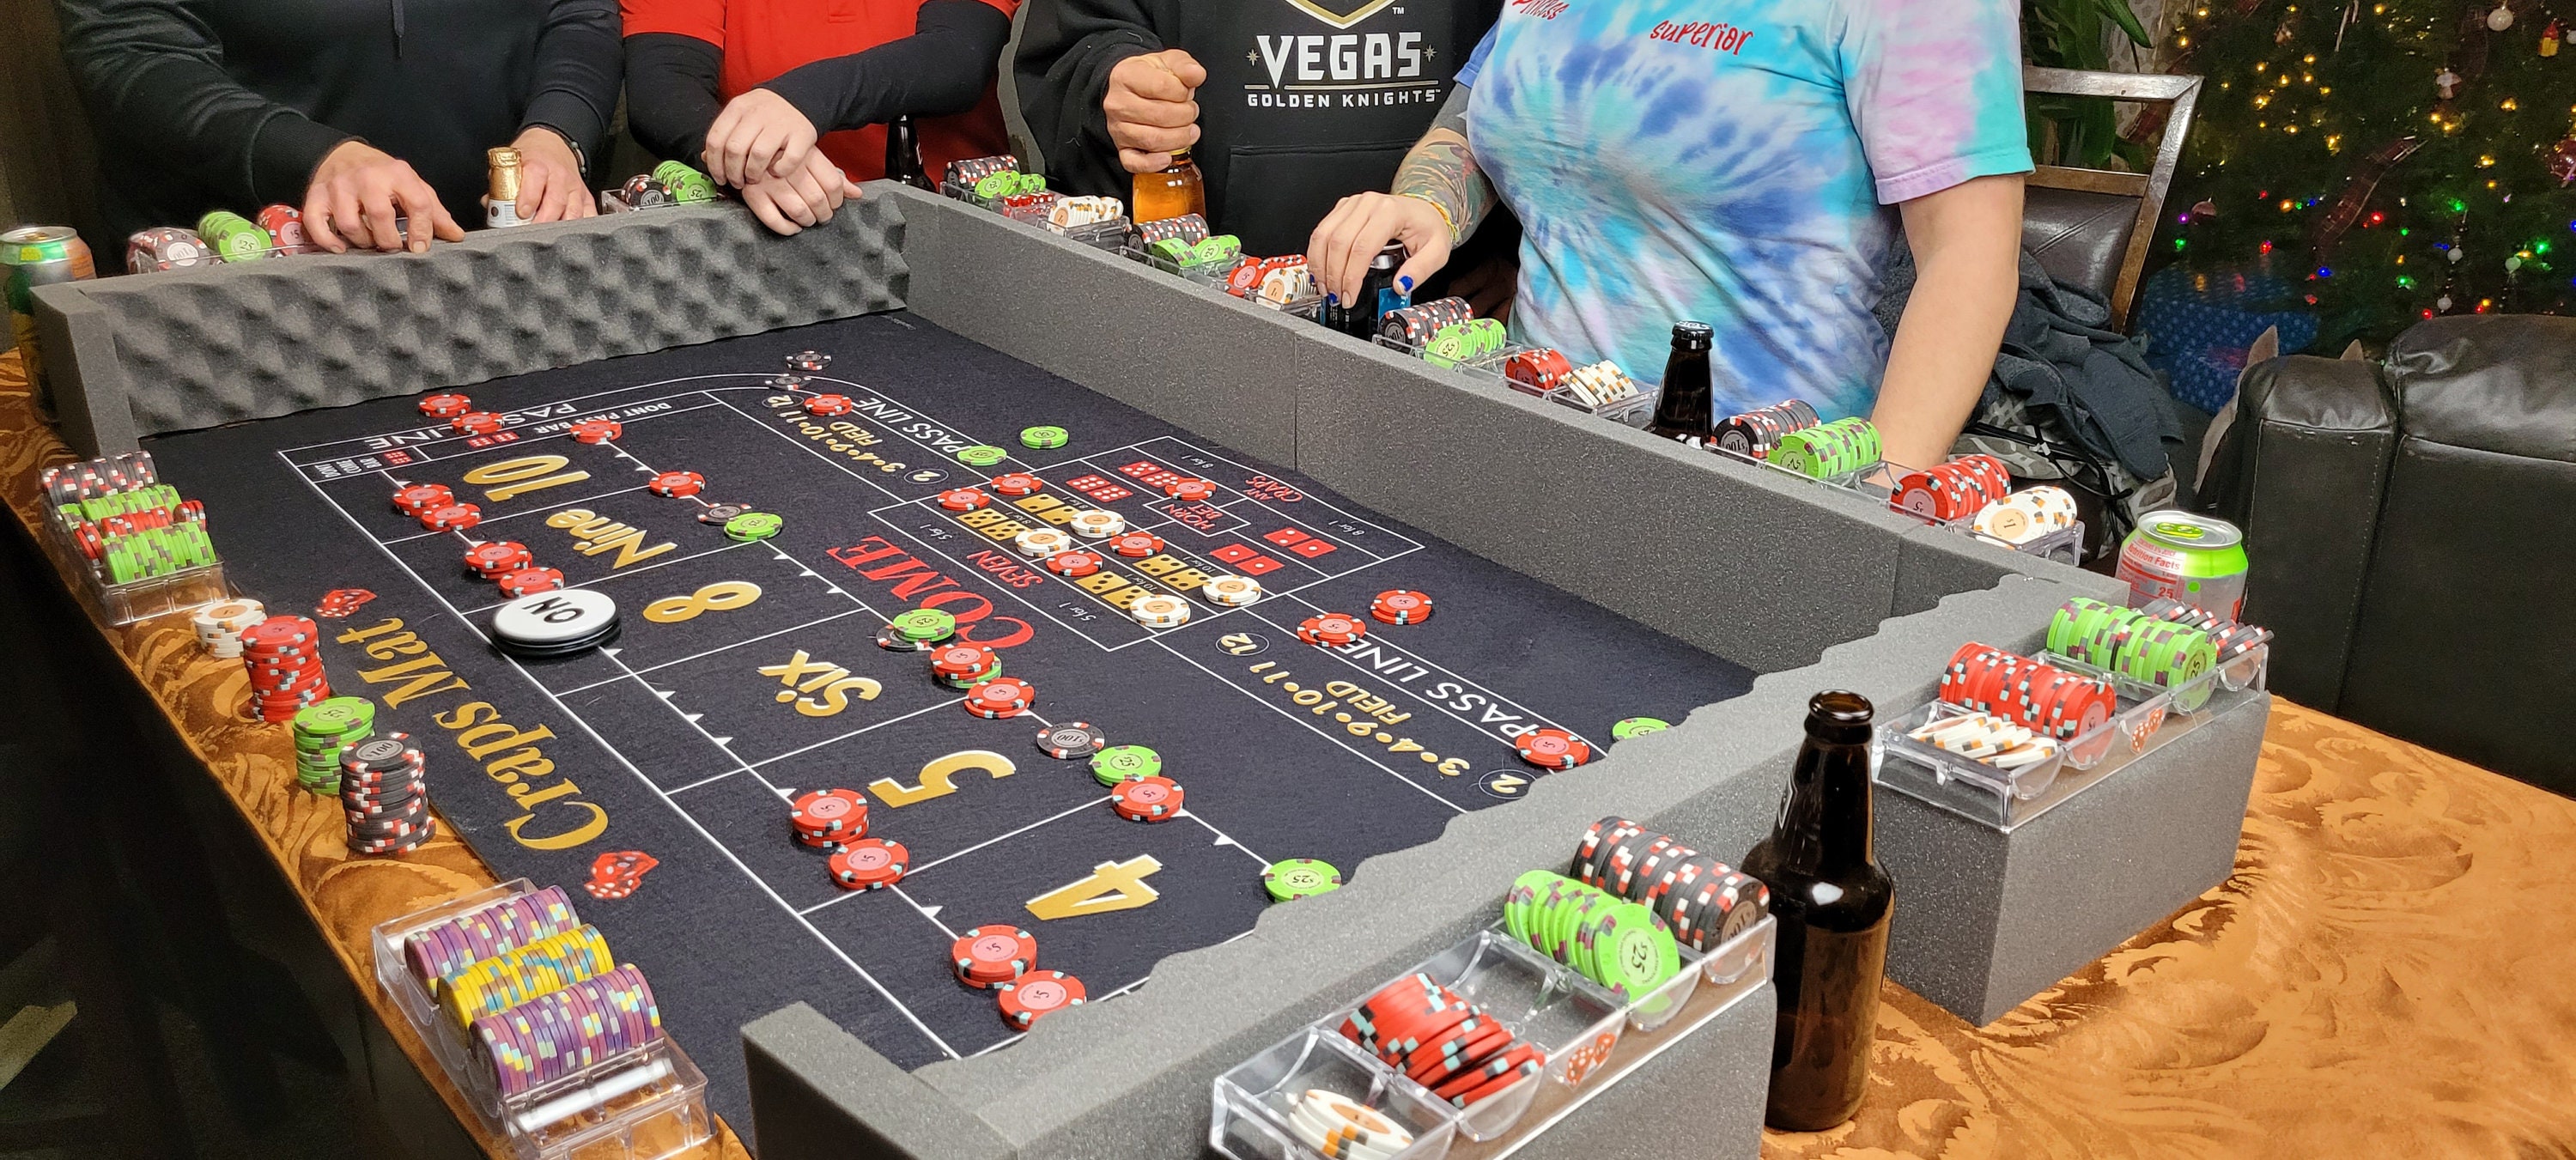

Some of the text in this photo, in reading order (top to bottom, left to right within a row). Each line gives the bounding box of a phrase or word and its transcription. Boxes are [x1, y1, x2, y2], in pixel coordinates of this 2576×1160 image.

[1650, 20, 1753, 56] superior
[1256, 32, 1422, 89] VEGAS
[1247, 90, 1437, 107] GOLDEN KNIGHTS
[240, 239, 255, 252] $25
[503, 403, 578, 425] PAS
[624, 402, 672, 416] DONT
[534, 422, 573, 434] BAR
[829, 421, 884, 446] FIELD
[852, 398, 972, 453] PASS LINE
[360, 457, 382, 469] BAR
[463, 455, 592, 502] 10
[1245, 475, 1303, 503] CRAPS
[1243, 488, 1274, 502] ANY
[1161, 503, 1216, 530] HORN
[1187, 503, 1224, 520] BET
[546, 508, 678, 569] Nine
[967, 550, 1044, 589] SEVEN
[2128, 543, 2154, 562] Nutrition
[2154, 557, 2181, 570] Facts
[643, 580, 762, 623] 8
[826, 536, 1036, 648] COME
[2158, 586, 2174, 598] 25
[521, 596, 585, 624] ON
[1220, 633, 1259, 654] 12
[756, 650, 883, 718] Six
[1334, 638, 1540, 738] PASS LINE
[1326, 681, 1413, 726] FIELD
[336, 617, 609, 850] Craps Mat
[1056, 734, 1084, 743] $100
[368, 742, 393, 756] $100
[867, 750, 1017, 808] 5
[1491, 774, 1528, 794] 2
[1025, 854, 1163, 920] 4
[1292, 875, 1315, 884] $25
[986, 942, 1002, 952] $5
[1632, 941, 1647, 974] $25
